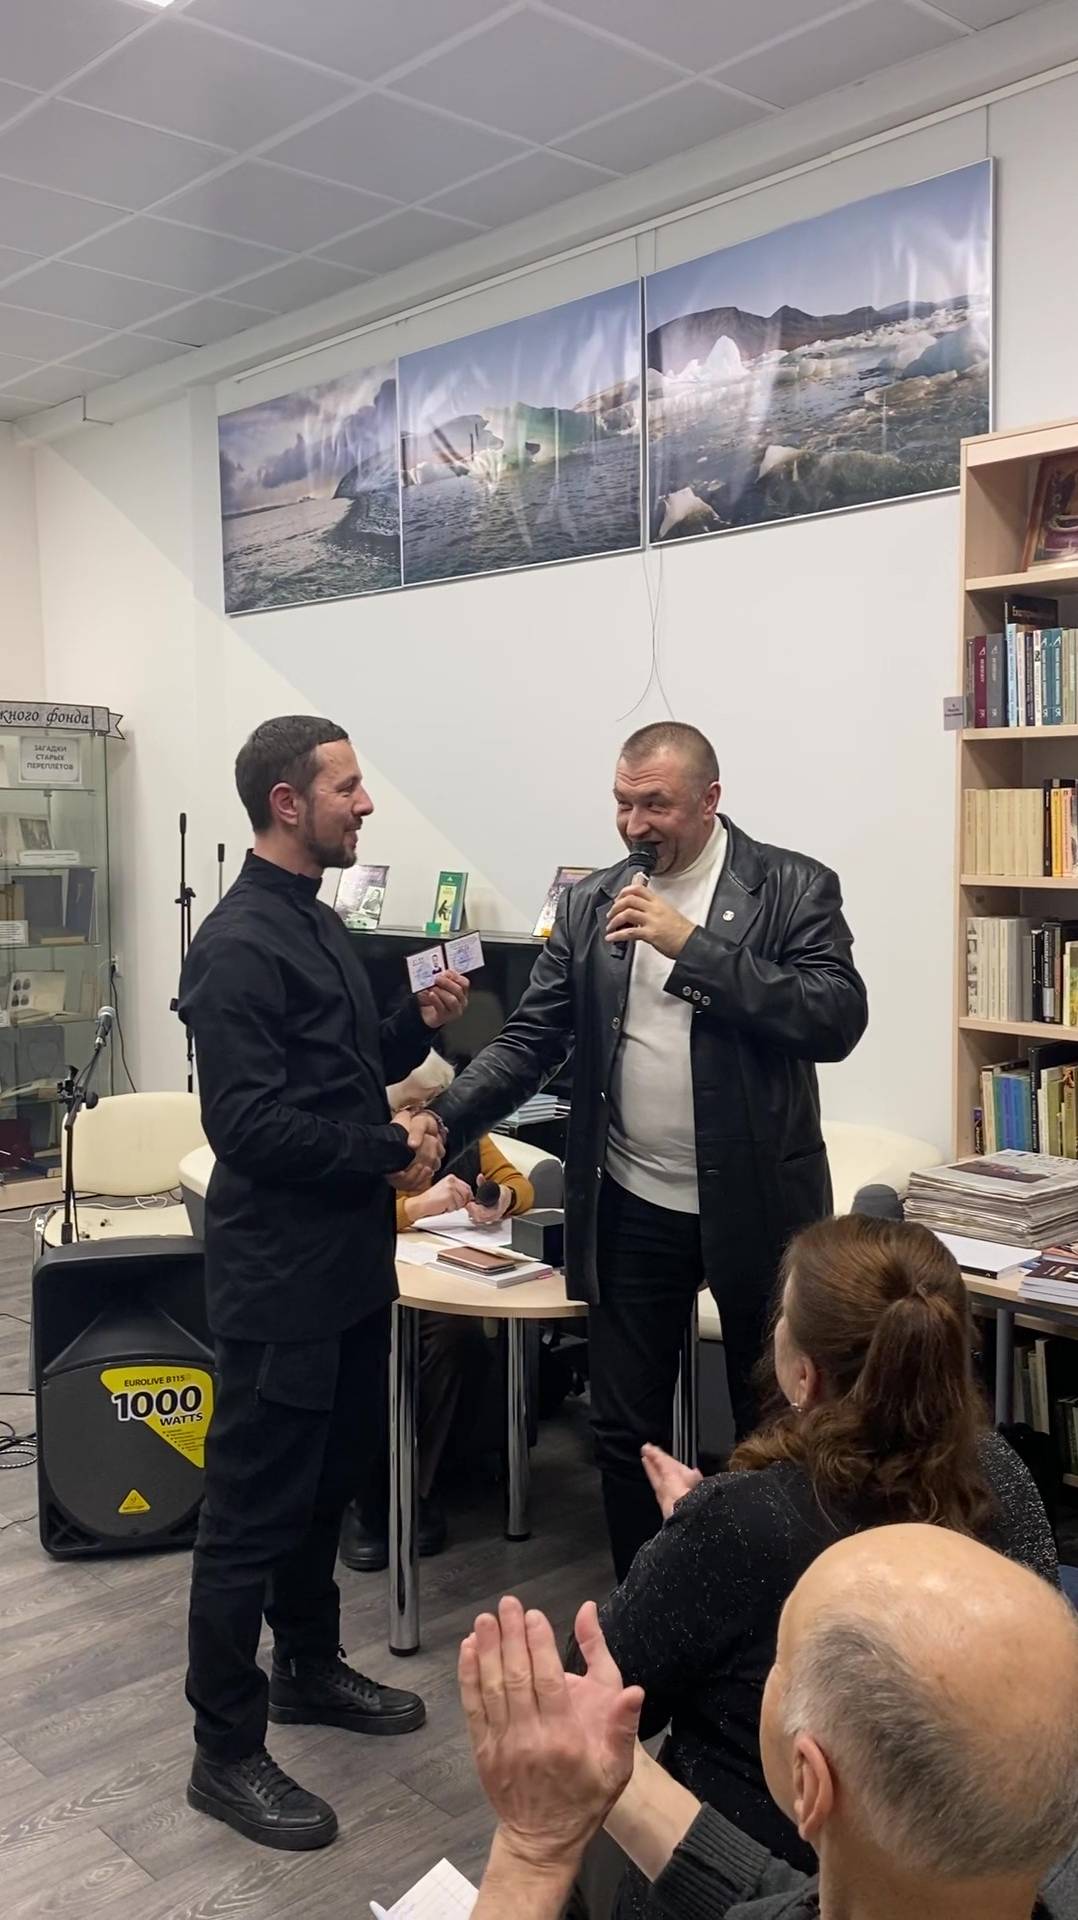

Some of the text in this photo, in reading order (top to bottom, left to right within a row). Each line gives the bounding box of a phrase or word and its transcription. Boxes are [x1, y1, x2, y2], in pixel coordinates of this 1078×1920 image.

[46, 707, 89, 726] фонда
[124, 1377, 164, 1387] EUROLIVE
[113, 1386, 203, 1420] 1000
[160, 1412, 203, 1426] WATTS
